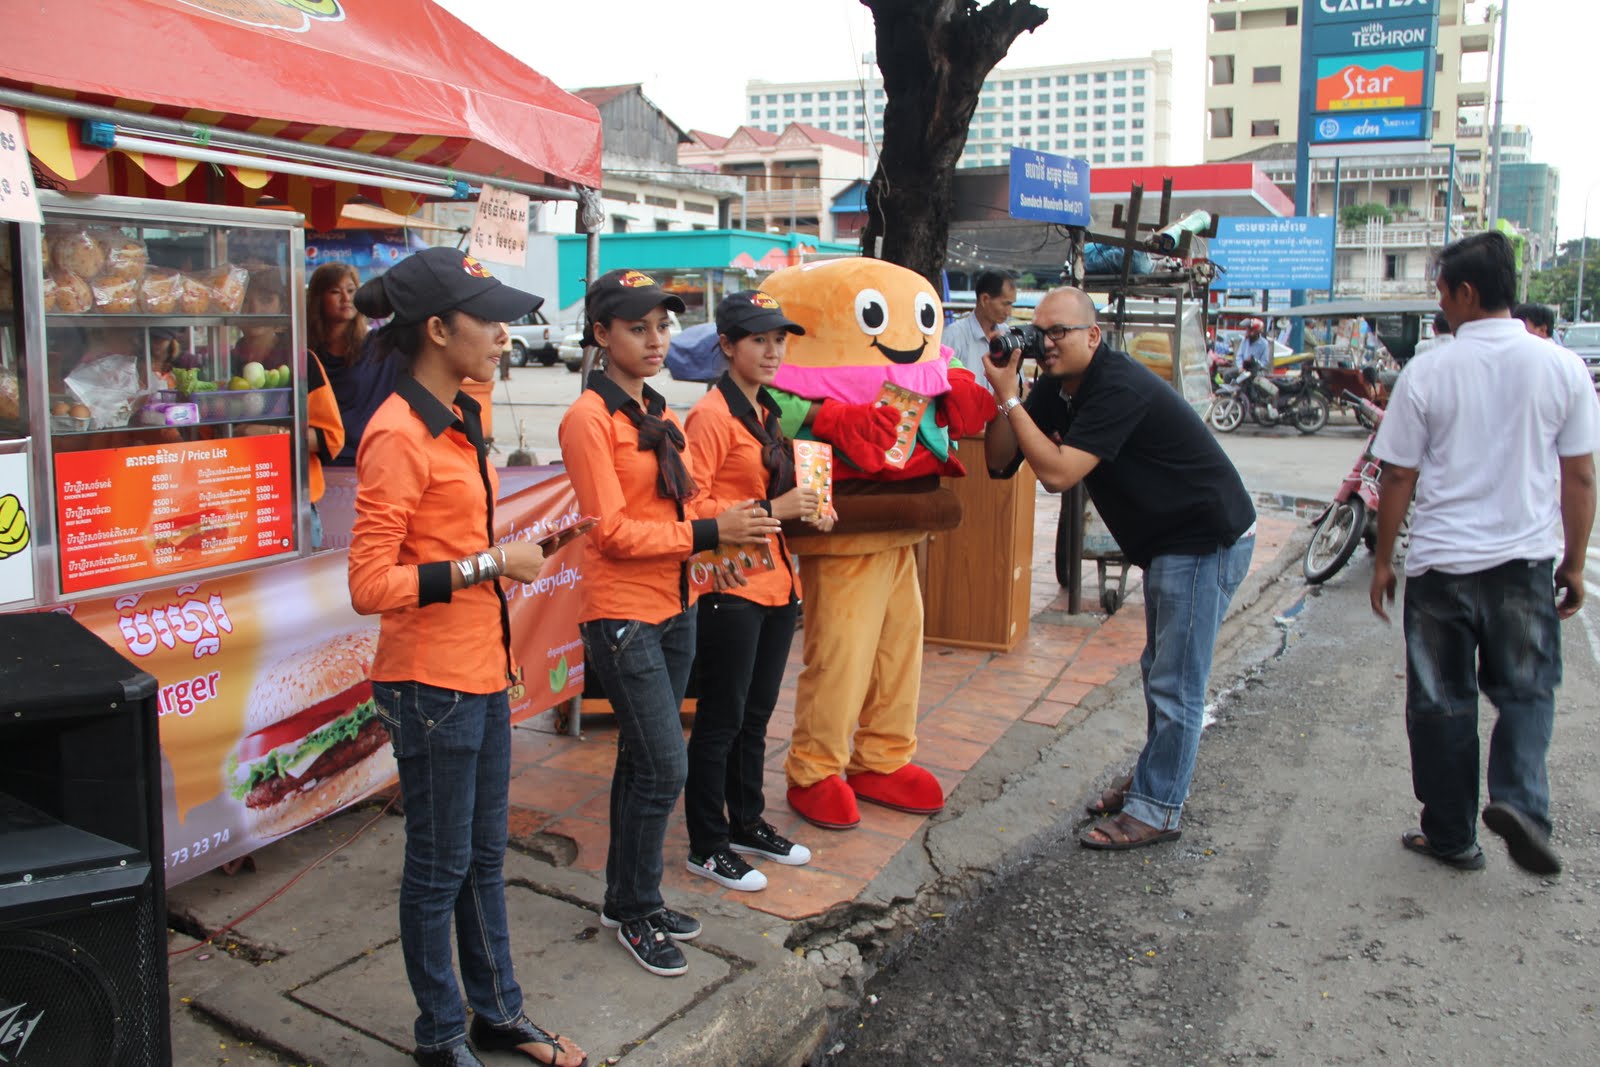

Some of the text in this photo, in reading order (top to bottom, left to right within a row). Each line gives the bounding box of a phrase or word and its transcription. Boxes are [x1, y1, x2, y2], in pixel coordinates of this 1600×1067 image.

[1320, 0, 1427, 13] CAL
[1361, 22, 1383, 33] with
[1352, 28, 1425, 47] TECHRON
[1342, 67, 1394, 99] Star
[1353, 118, 1380, 136] atm
[188, 450, 210, 461] Price
[212, 448, 227, 458] List
[172, 847, 188, 868] 73
[192, 838, 209, 858] 23
[213, 828, 230, 848] 74
